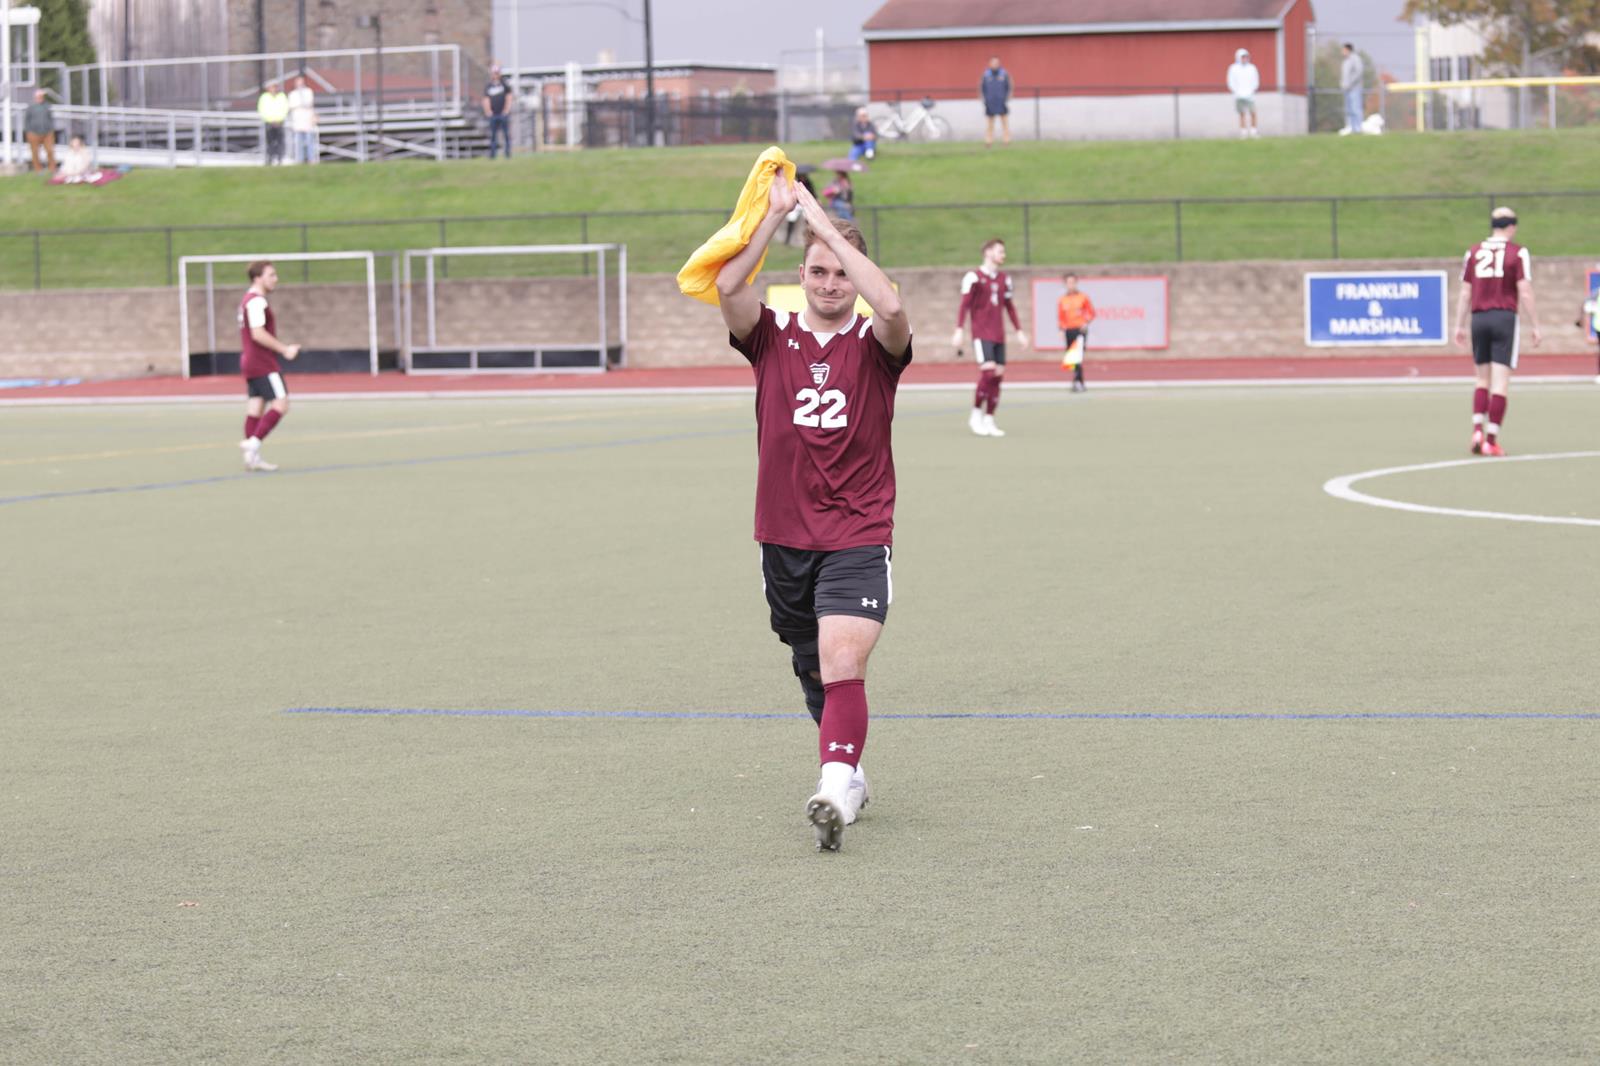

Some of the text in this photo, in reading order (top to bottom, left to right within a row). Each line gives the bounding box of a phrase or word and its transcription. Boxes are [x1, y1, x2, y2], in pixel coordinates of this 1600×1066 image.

[1475, 249, 1504, 278] 21
[1336, 283, 1419, 299] FRANKLIN
[1096, 304, 1146, 320] NSON
[1368, 300, 1383, 316] &
[1330, 318, 1422, 334] MARSHALL
[793, 388, 847, 428] 22
